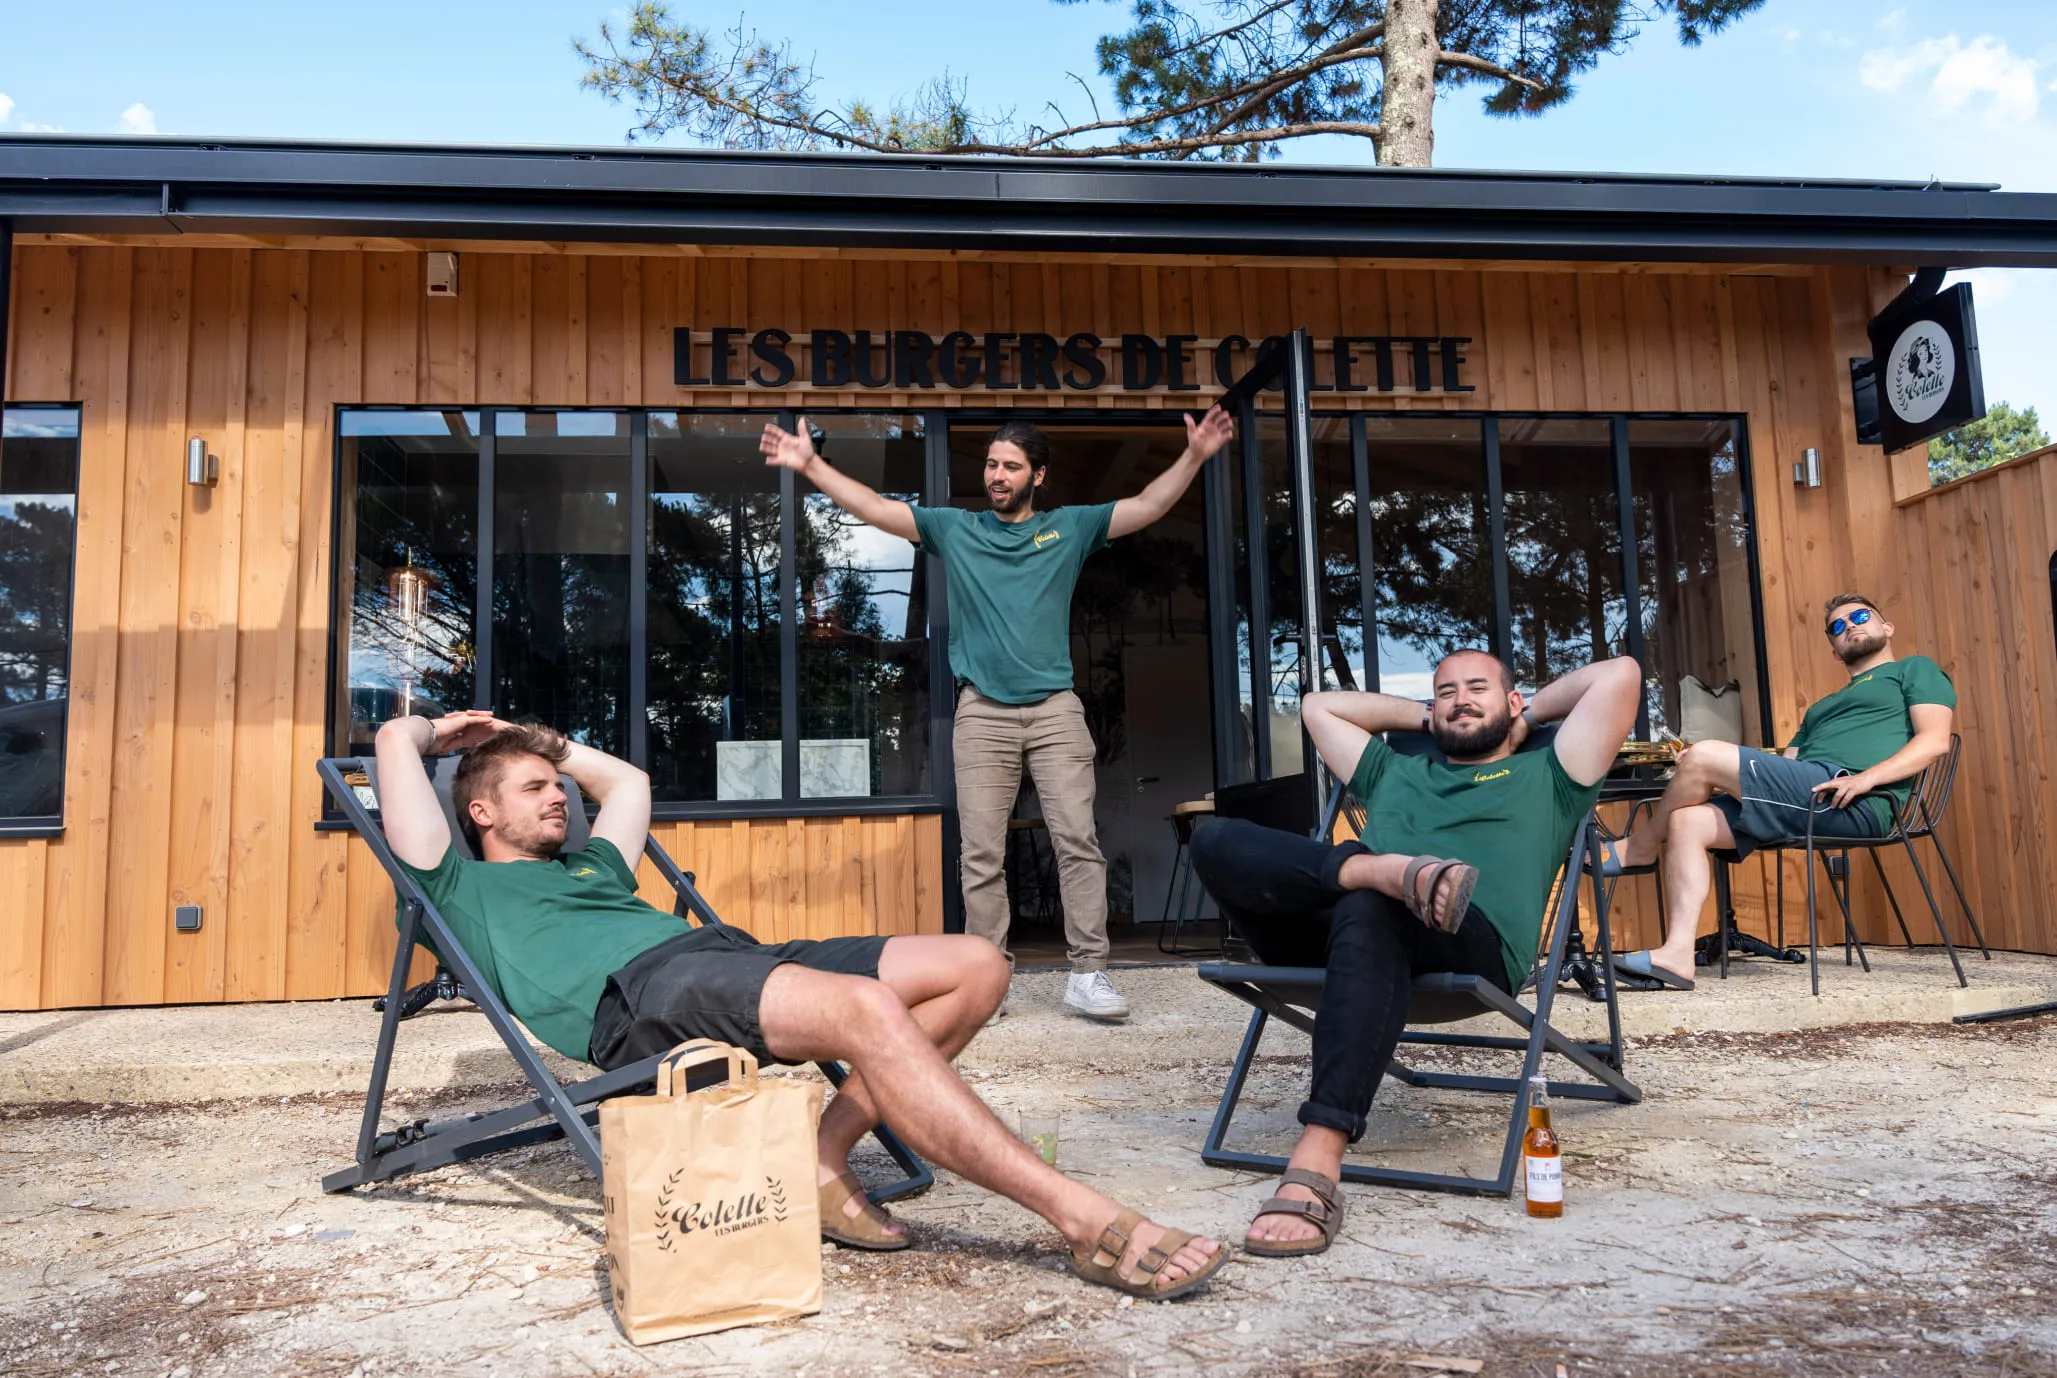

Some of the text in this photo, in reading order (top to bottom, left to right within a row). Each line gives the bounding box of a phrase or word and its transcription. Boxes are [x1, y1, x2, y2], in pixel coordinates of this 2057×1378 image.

[673, 327, 795, 387] LES
[811, 329, 1106, 390] BURGERS
[1121, 334, 1201, 390] DE
[1905, 374, 1945, 400] Colette
[671, 1192, 767, 1235] Colette
[714, 1215, 770, 1237] LES BURGERS
